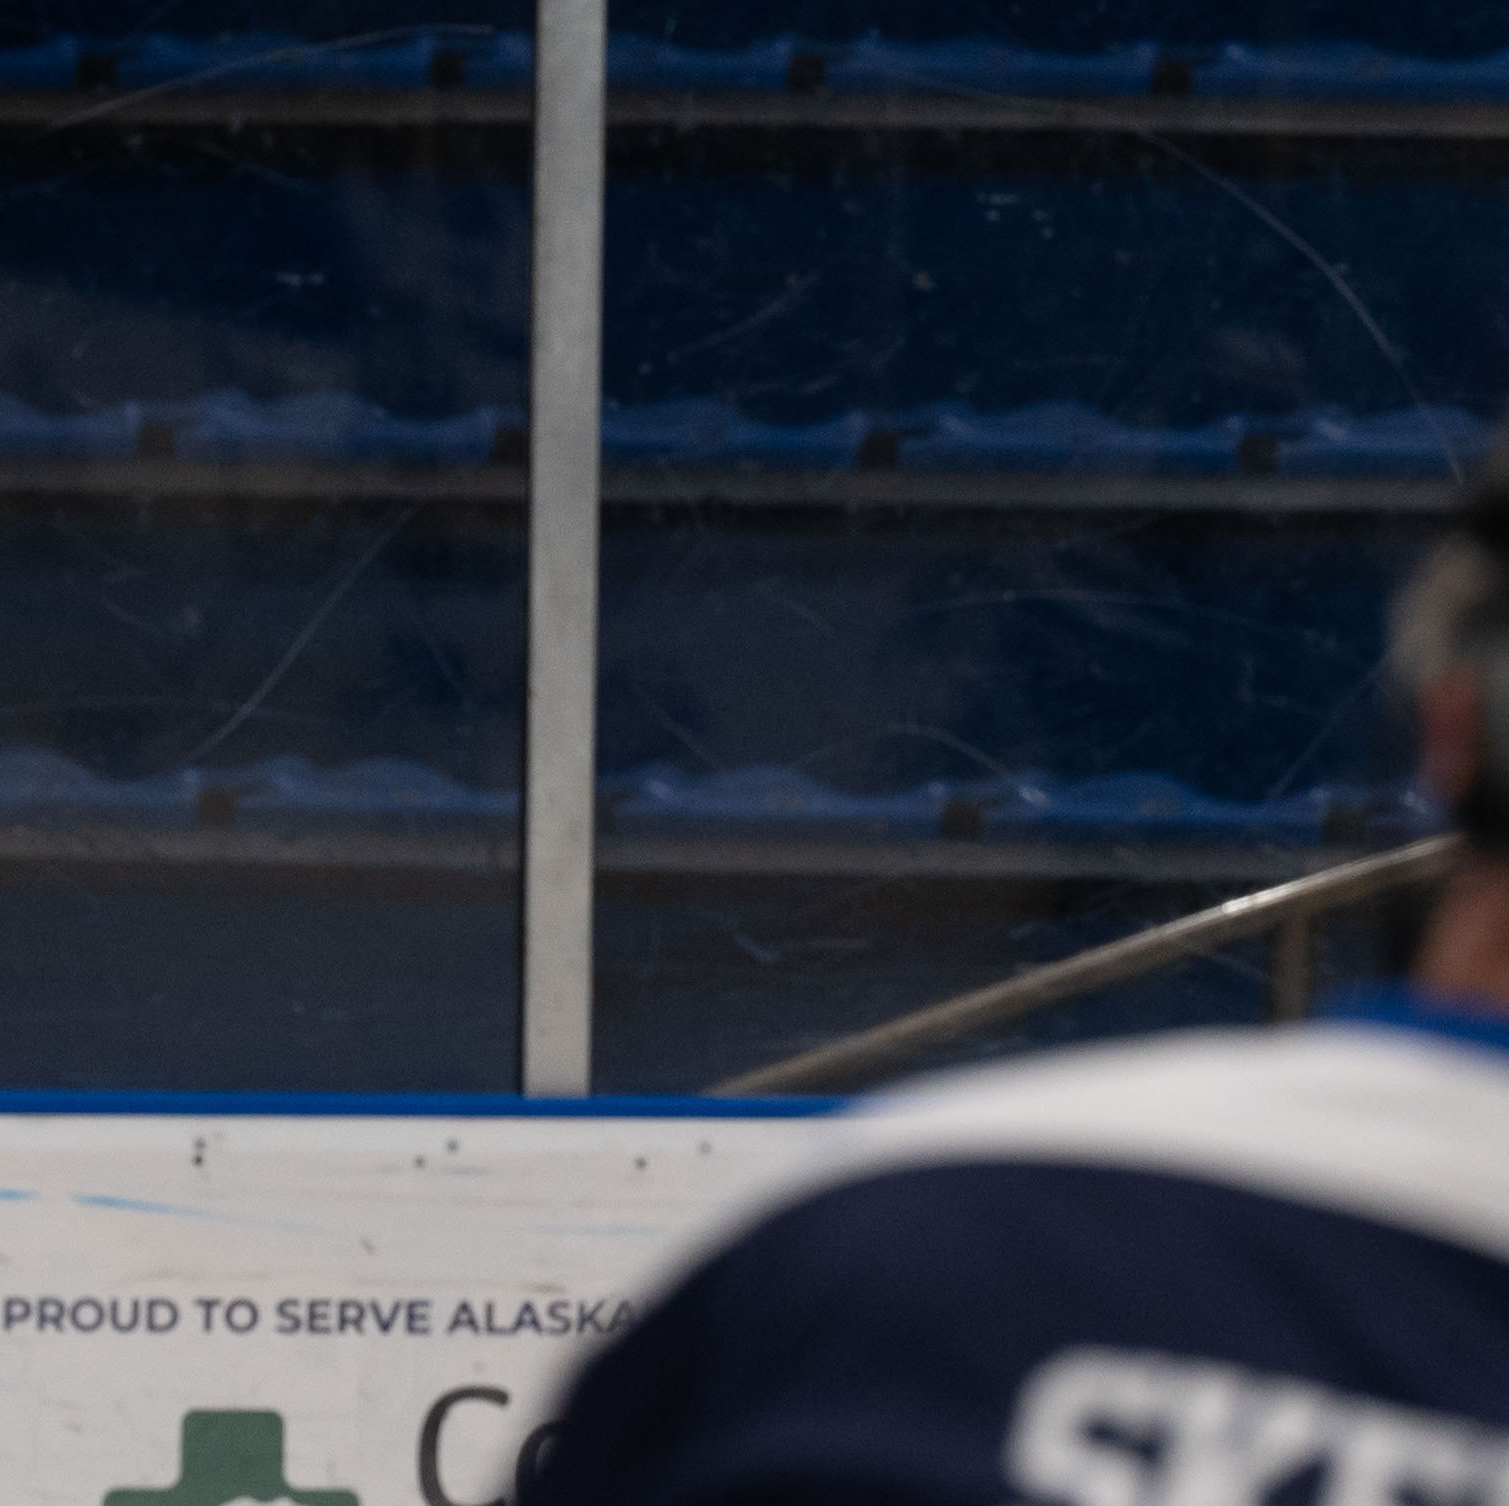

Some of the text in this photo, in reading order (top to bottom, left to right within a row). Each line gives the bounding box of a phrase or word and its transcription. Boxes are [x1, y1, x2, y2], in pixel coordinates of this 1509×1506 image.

[2, 1297, 179, 1334] PROUD
[194, 1298, 261, 1334] TO
[274, 1298, 432, 1335] SERVE
